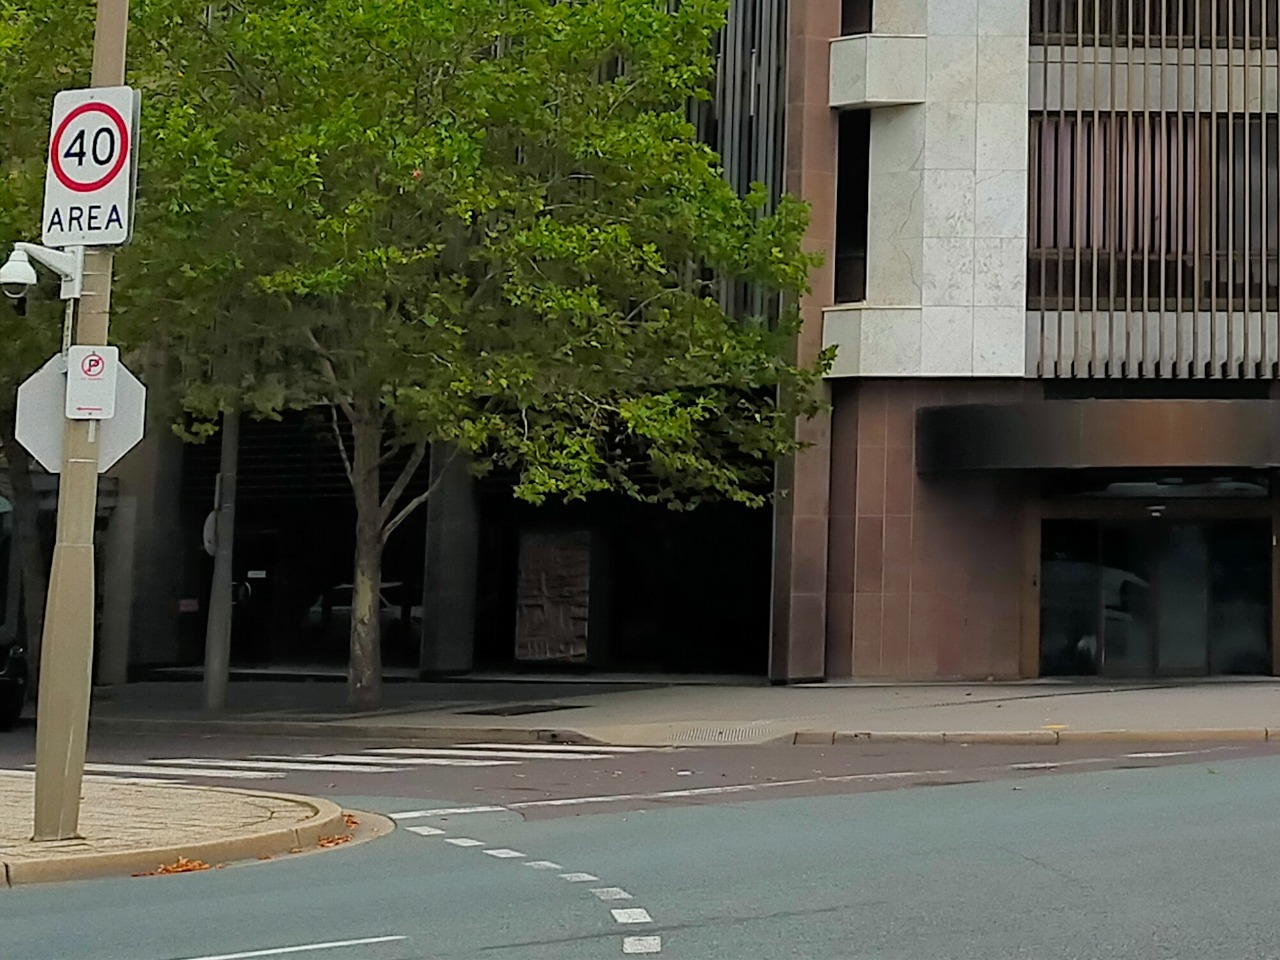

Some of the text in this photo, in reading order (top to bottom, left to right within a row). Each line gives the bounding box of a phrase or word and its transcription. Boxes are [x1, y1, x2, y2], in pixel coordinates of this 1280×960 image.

[63, 127, 115, 166] 40
[47, 204, 123, 233] AREA
[88, 359, 100, 372] P
